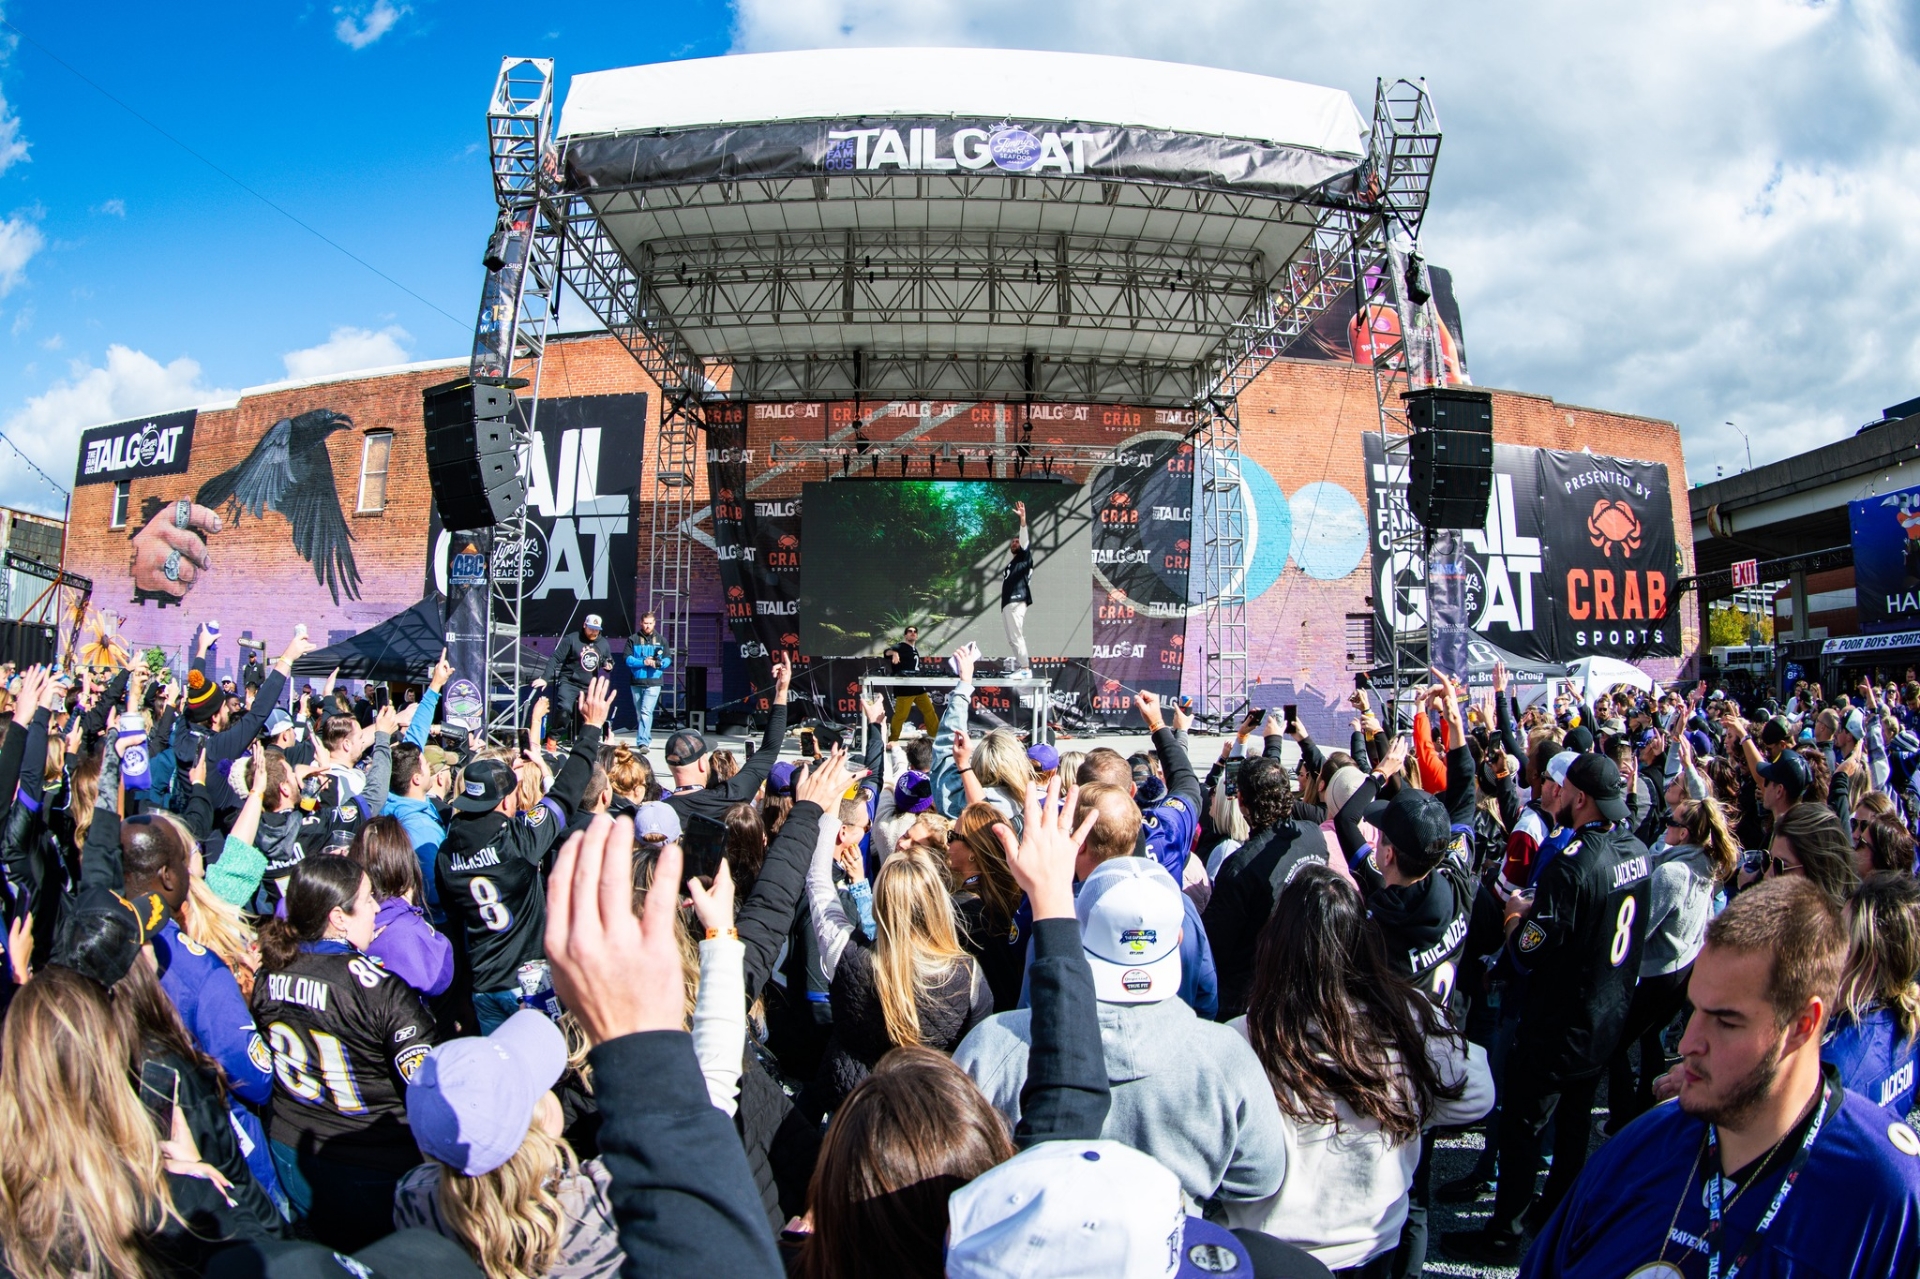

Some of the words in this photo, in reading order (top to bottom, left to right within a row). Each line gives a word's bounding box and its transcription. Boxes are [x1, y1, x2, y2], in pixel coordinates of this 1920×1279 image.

[1103, 411, 1141, 426] CRAB
[1564, 470, 1631, 495] PRESENTED
[1635, 483, 1651, 500] BY
[1101, 509, 1139, 523] CRAB
[452, 553, 485, 578] ABC
[769, 552, 802, 566] CRA
[1732, 560, 1757, 587] EXIT
[1566, 568, 1668, 621] CRAB
[1886, 590, 1920, 614] HA
[726, 603, 752, 617] RAB
[1099, 605, 1135, 619] CRAB
[1576, 629, 1664, 646] SPORTS
[1838, 638, 1864, 650] POOR
[1864, 636, 1888, 648] BOYS
[1516, 671, 1544, 683] Group
[972, 695, 1010, 709] CRAB
[1093, 696, 1131, 709] CRAB
[1613, 855, 1649, 888] JACKSON
[469, 875, 513, 934] 8
[1610, 895, 1637, 967] 8
[268, 973, 328, 1012] BOLDIN
[399, 1048, 430, 1063] RAVENS
[268, 1020, 370, 1116] 81
[1877, 1059, 1914, 1108] JACKSON
[1669, 1227, 1709, 1254] RAVENS
